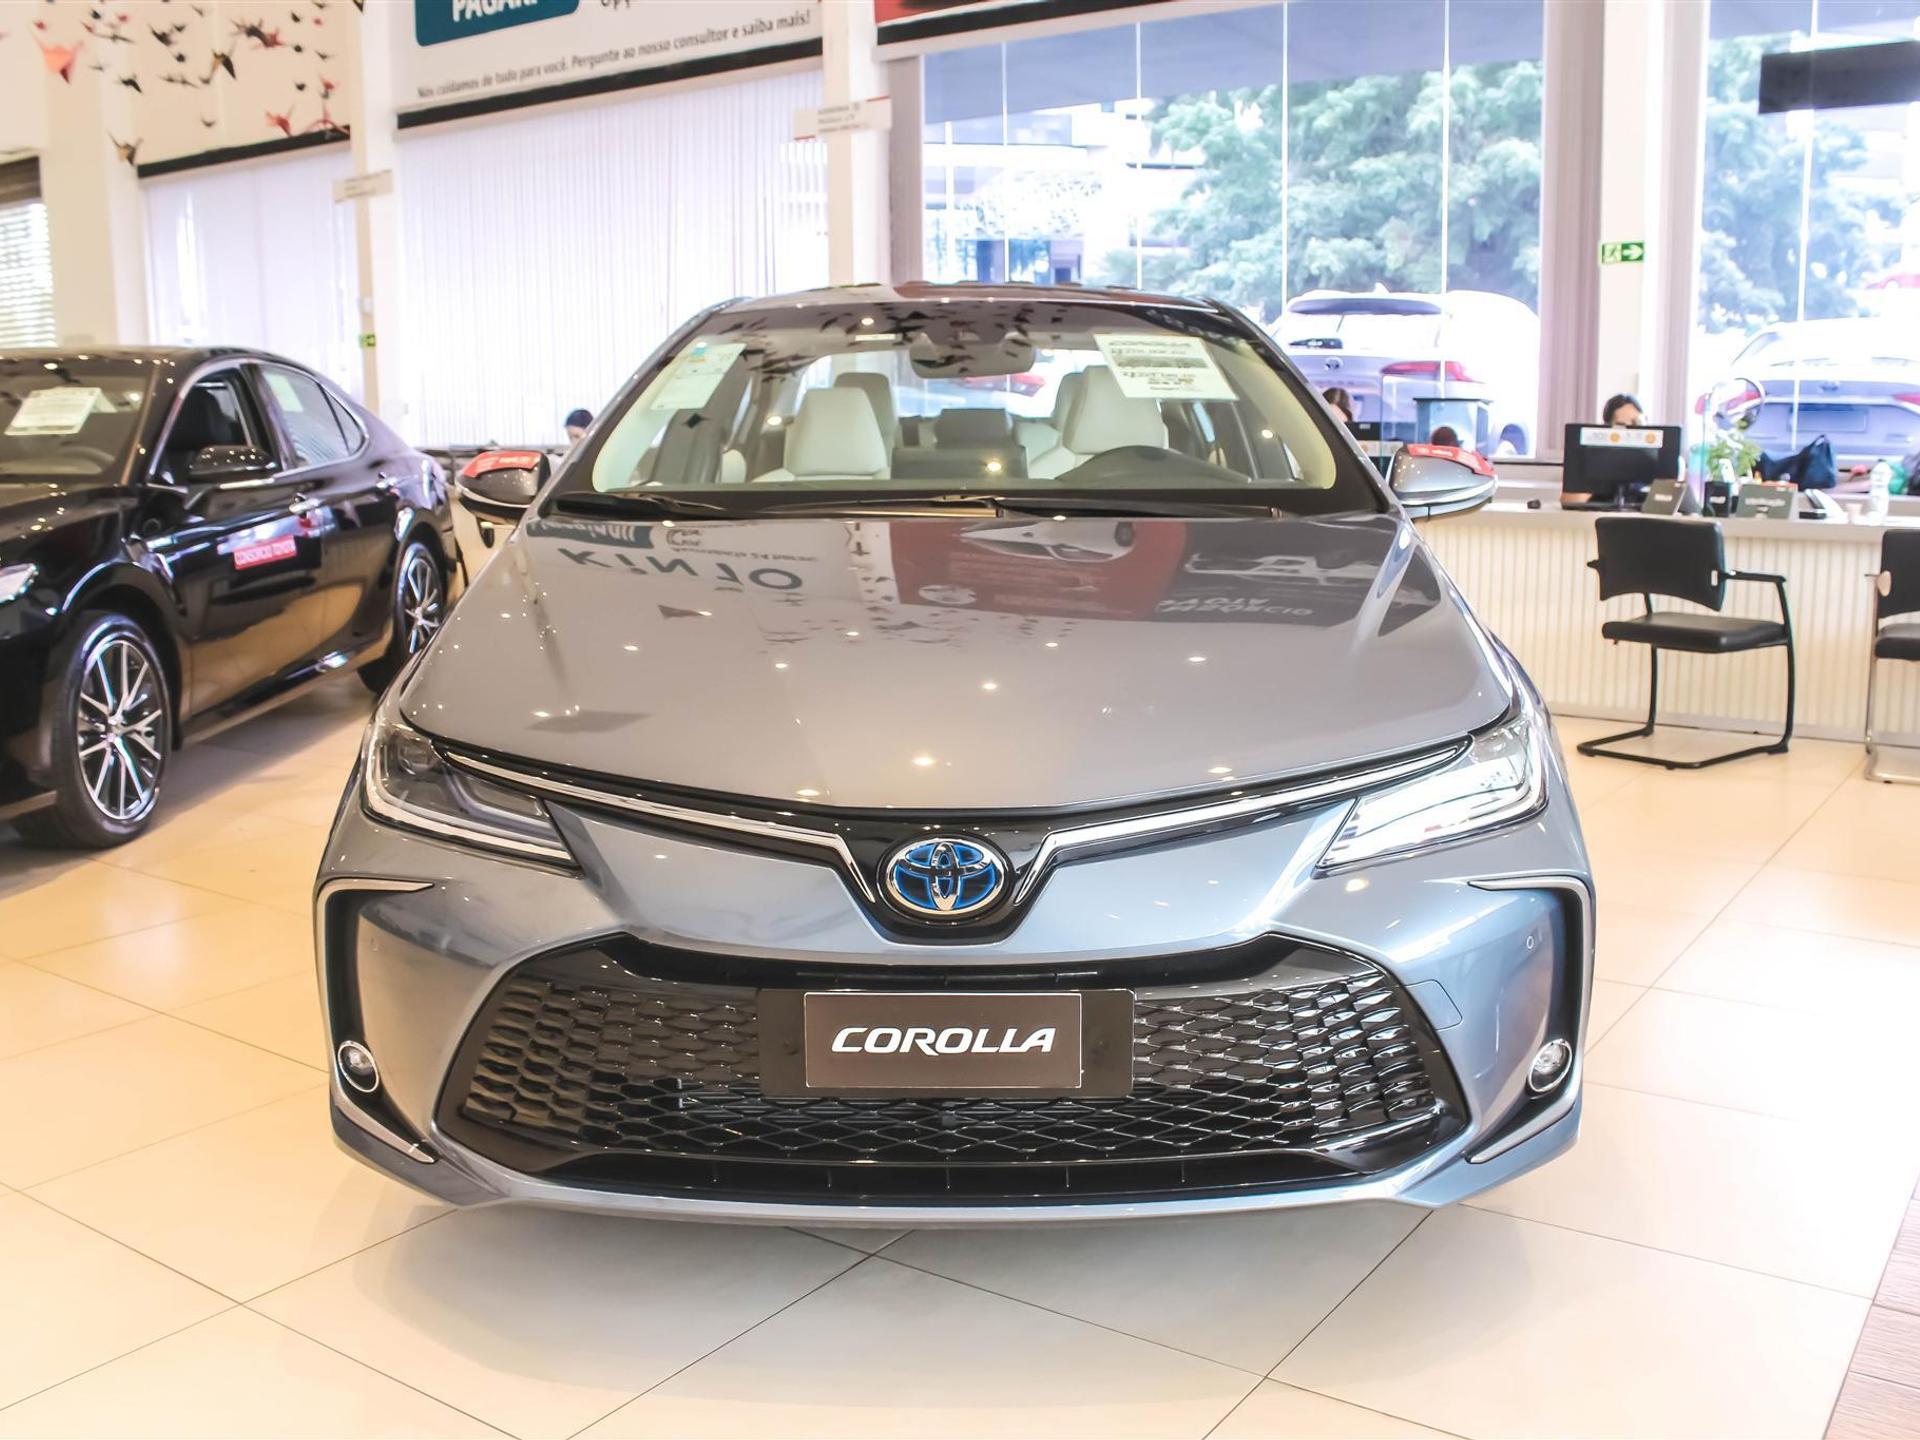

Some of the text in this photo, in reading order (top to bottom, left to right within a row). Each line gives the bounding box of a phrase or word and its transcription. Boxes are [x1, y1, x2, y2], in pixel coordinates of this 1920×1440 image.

[482, 73, 493, 88] de
[495, 69, 518, 84] tudo
[519, 65, 541, 80] para
[571, 49, 619, 70] Pergunte
[623, 46, 636, 59] ao
[638, 39, 671, 56] nosso
[673, 27, 729, 50] consultor
[732, 26, 738, 38] e
[742, 18, 773, 37] saiba
[776, 8, 810, 31] mais!
[831, 1027, 1056, 1056] COROLLA
